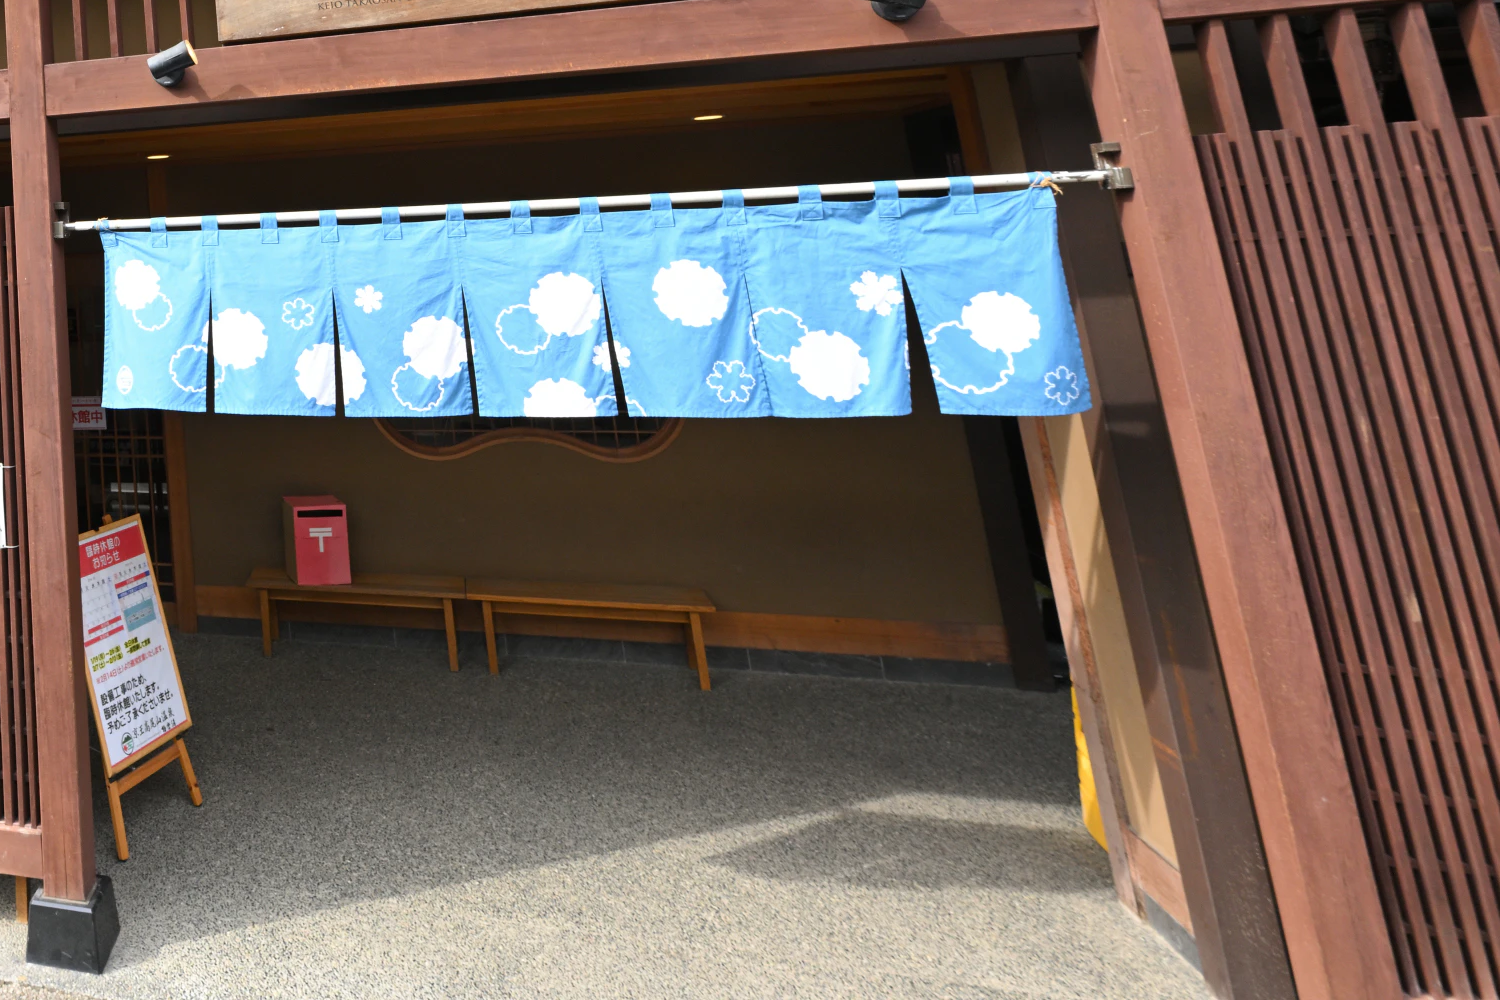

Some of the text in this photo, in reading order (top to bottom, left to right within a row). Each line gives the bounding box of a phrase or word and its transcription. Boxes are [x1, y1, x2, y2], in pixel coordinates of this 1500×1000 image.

[317, 0, 343, 11] KEIO
[85, 536, 121, 558] 臨時休館の
[92, 550, 120, 569] お知らせ
